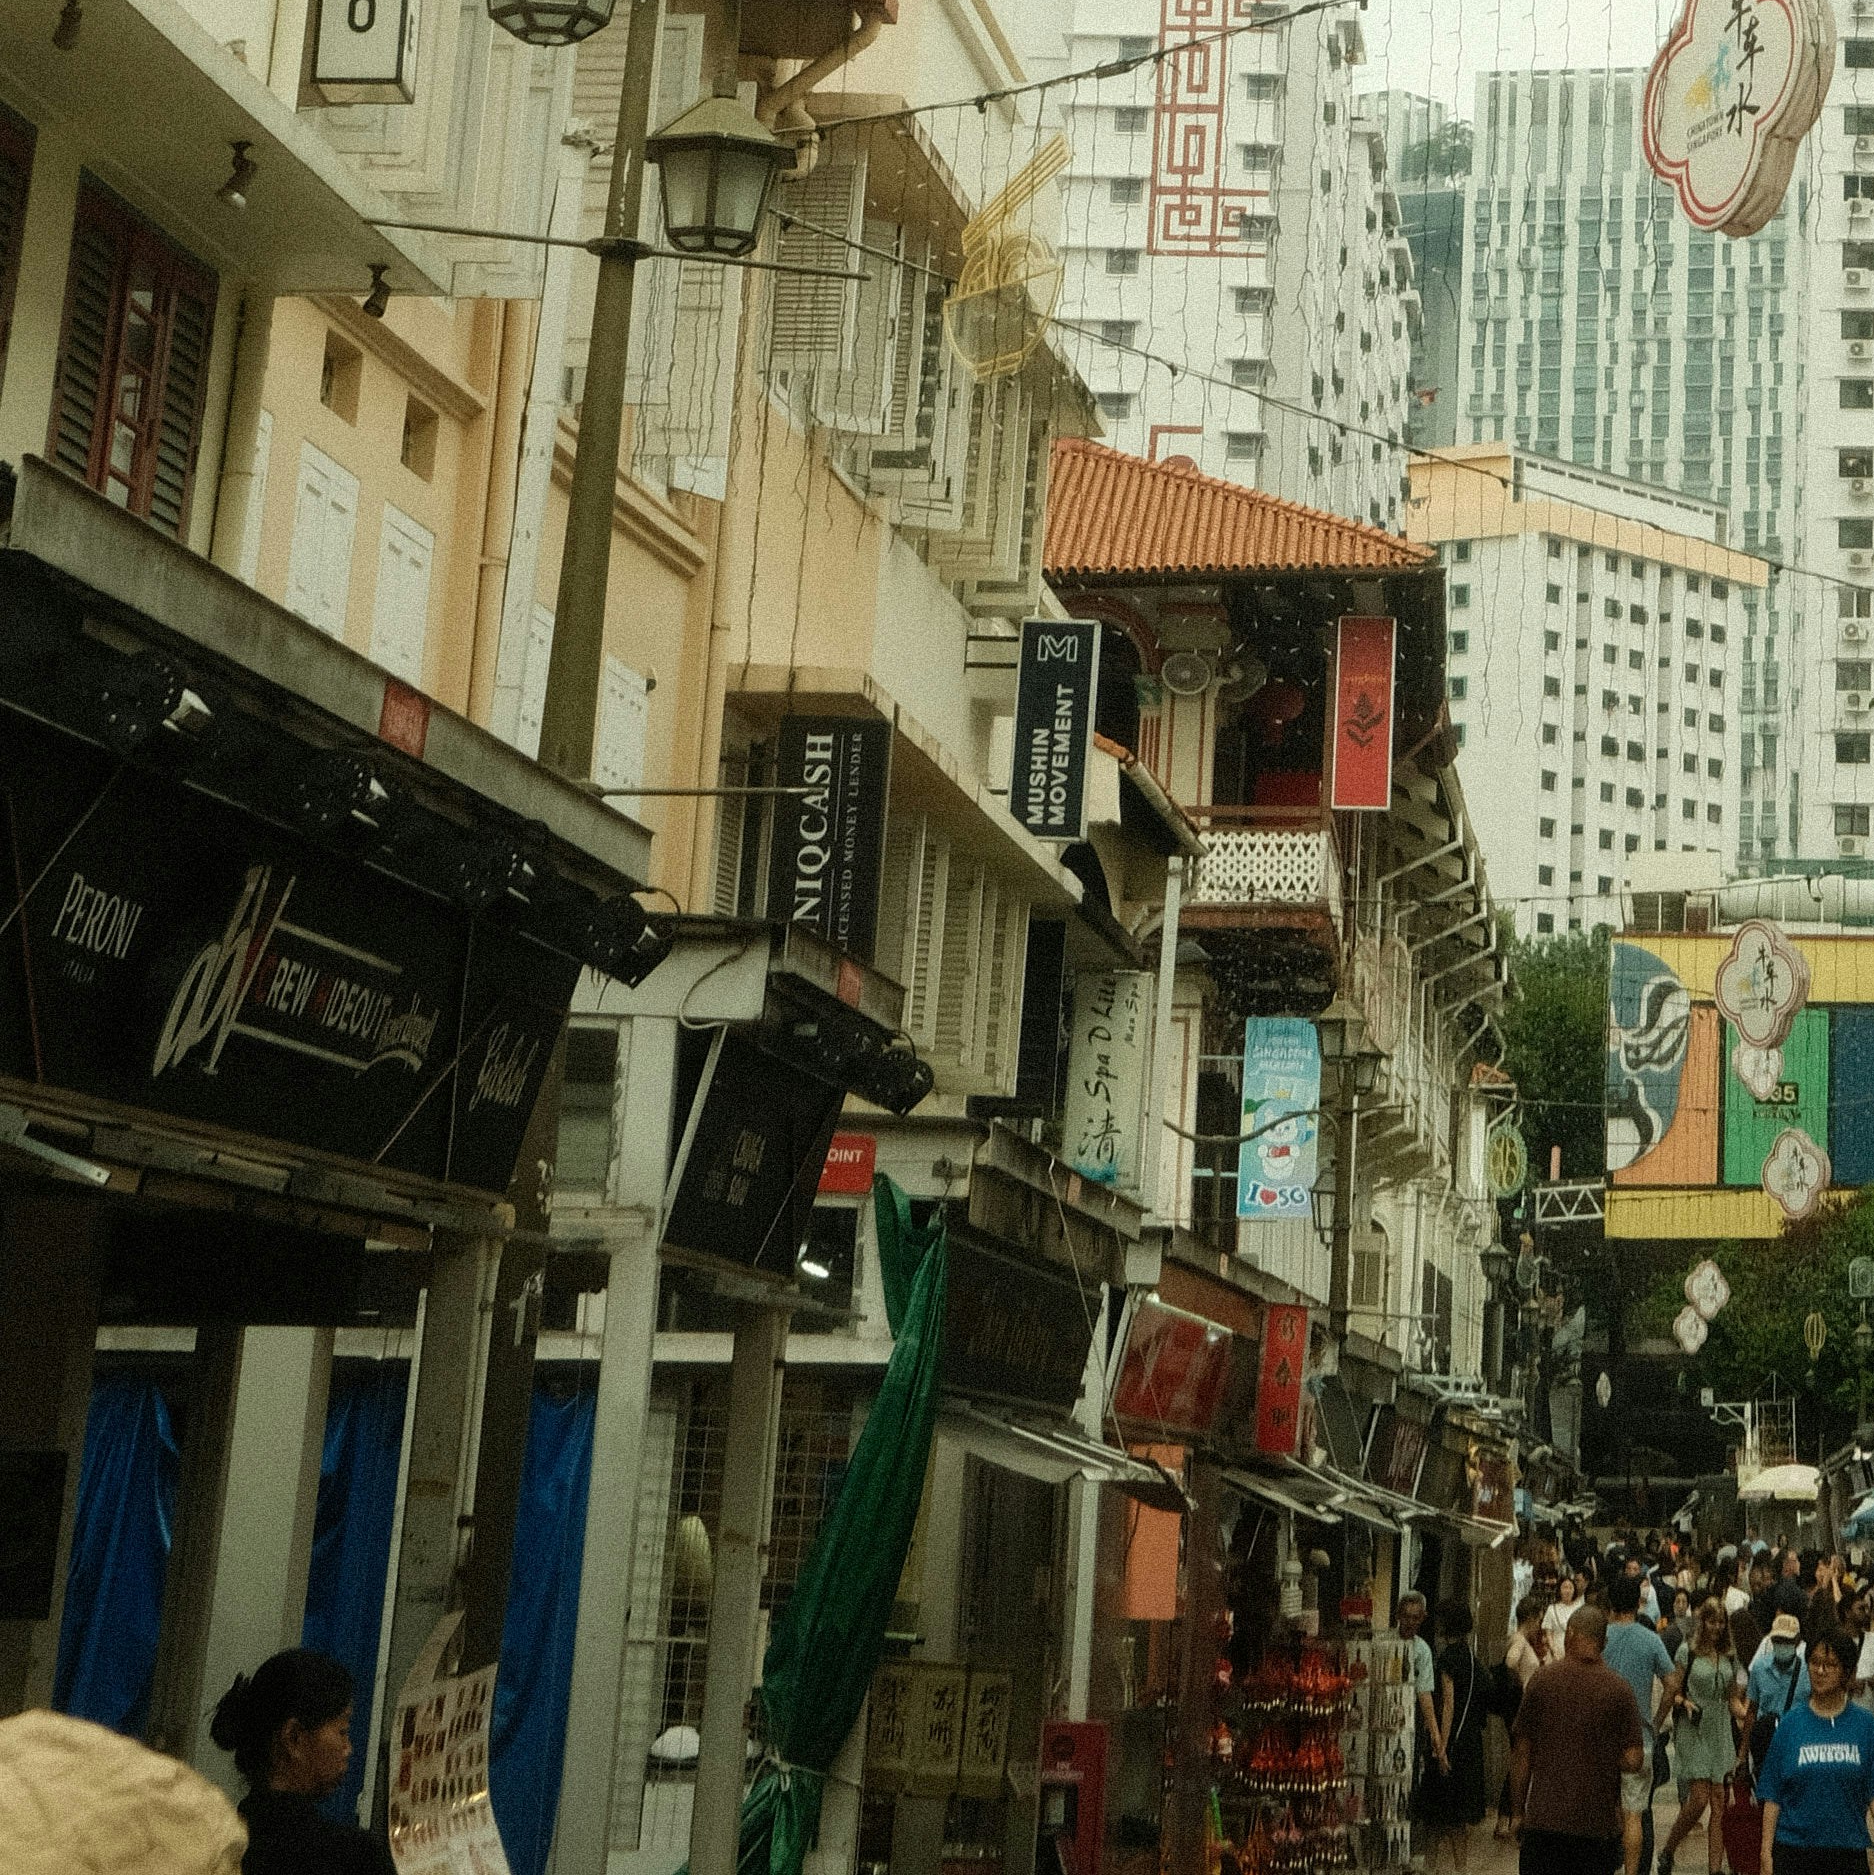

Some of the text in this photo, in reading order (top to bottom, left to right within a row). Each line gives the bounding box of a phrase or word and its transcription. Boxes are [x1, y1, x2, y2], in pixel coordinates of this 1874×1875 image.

[848, 731, 863, 799] LENDER
[1027, 728, 1050, 825] MUSHIN
[1048, 683, 1075, 825] MOVEMENT
[793, 733, 834, 935] NIQCASH
[843, 805, 858, 863] MONEY
[52, 872, 143, 959] PERONI
[252, 953, 320, 1017] CREW
[1084, 1053, 1118, 1104] Spa
[827, 1149, 864, 1163] OINT
[1798, 1744, 1861, 1765] AWESOME
